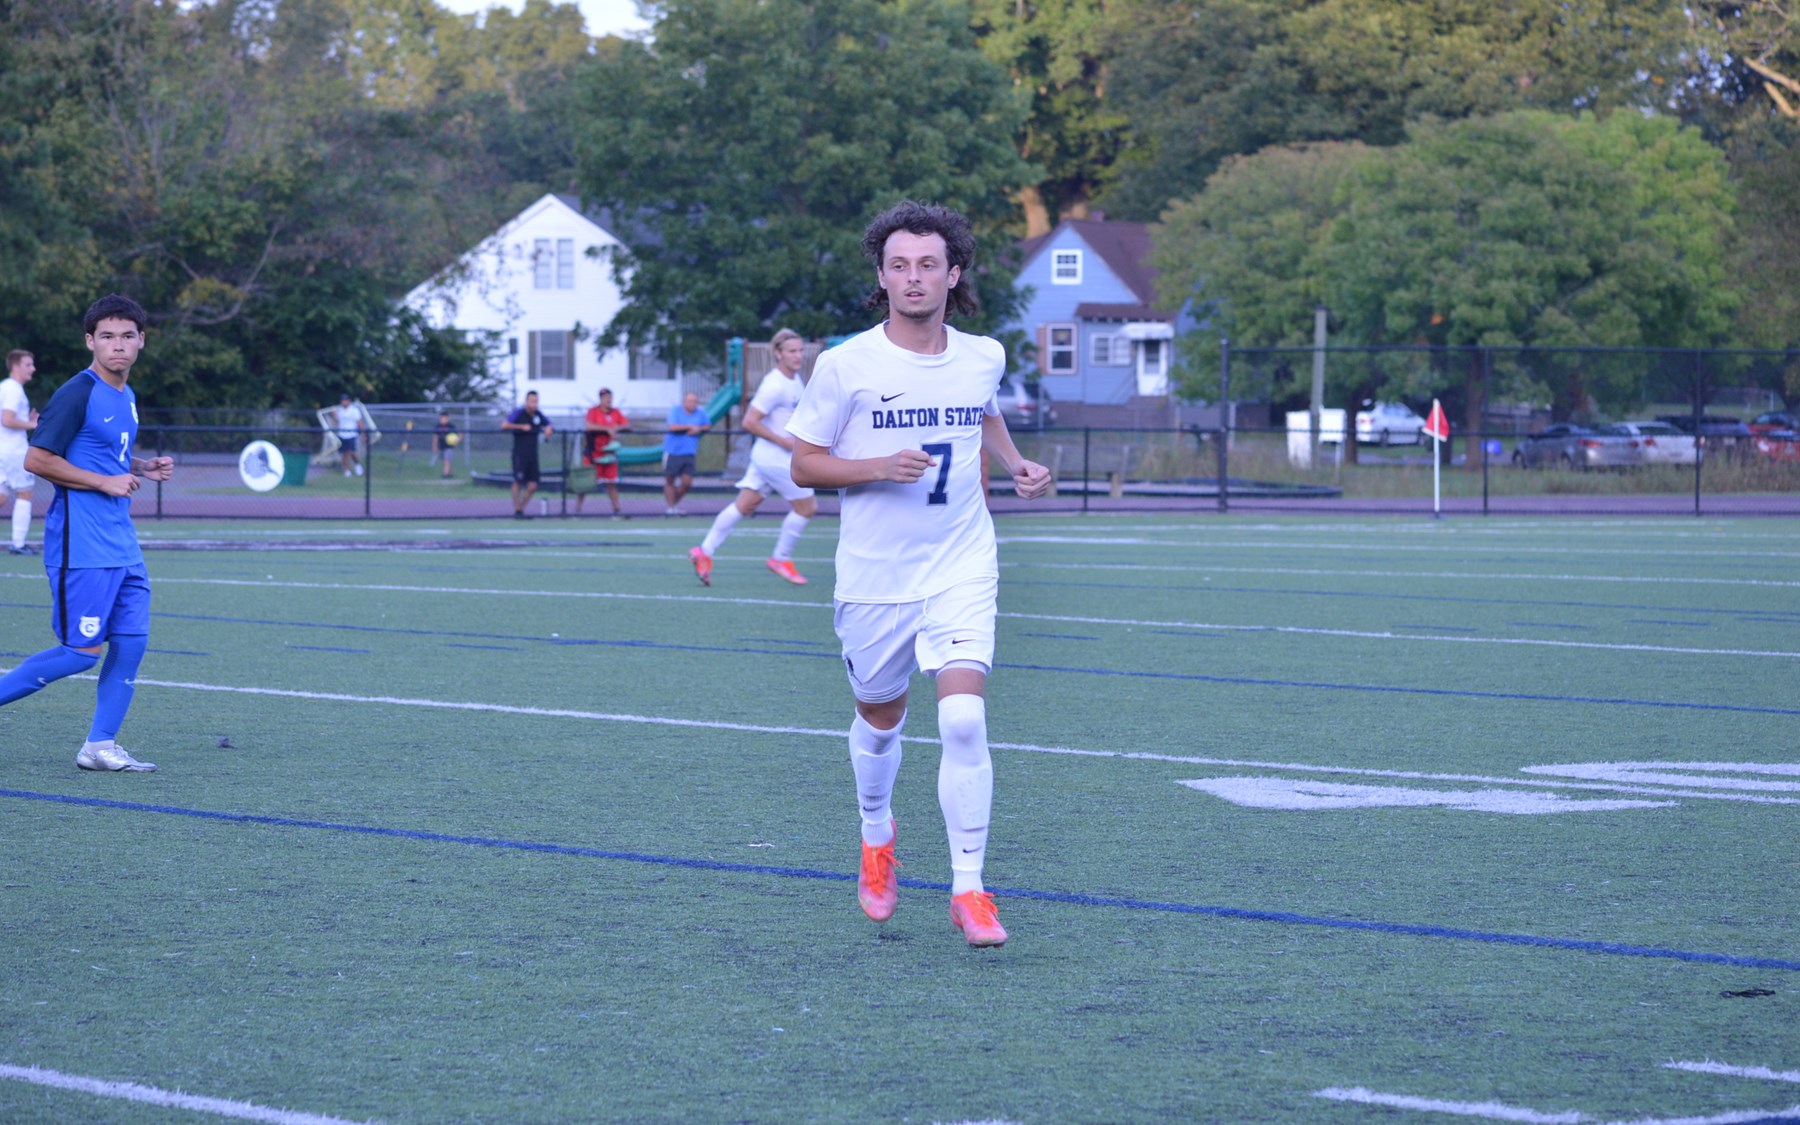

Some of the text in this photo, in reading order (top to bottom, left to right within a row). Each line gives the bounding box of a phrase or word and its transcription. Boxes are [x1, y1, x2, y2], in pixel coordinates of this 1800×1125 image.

[872, 407, 939, 429] DALTON
[119, 431, 129, 462] 7
[921, 441, 952, 505] 7
